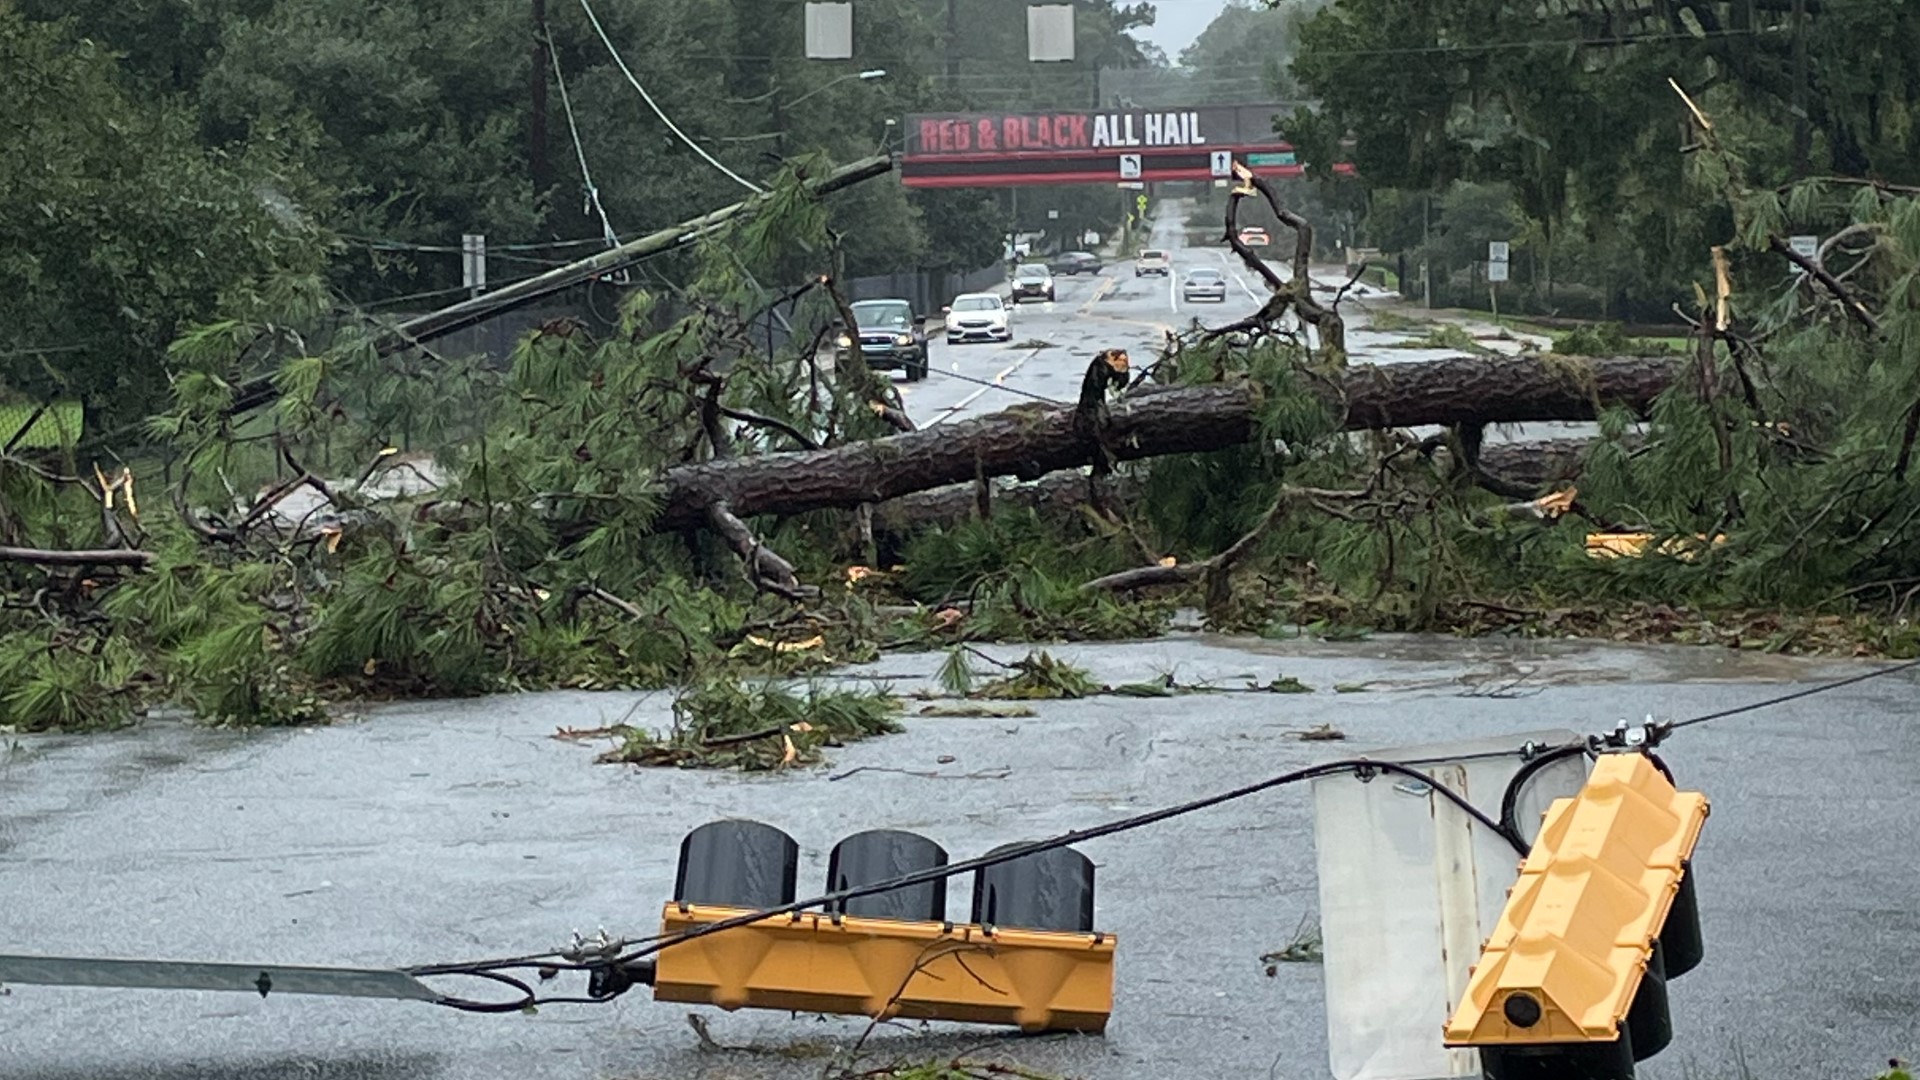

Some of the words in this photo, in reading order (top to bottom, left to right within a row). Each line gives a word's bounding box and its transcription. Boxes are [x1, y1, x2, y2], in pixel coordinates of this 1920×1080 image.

[920, 119, 970, 151] RED
[977, 119, 997, 149] &
[1003, 115, 1087, 148] BLACK
[1092, 114, 1140, 147] ALL
[1144, 112, 1205, 145] HAIL
